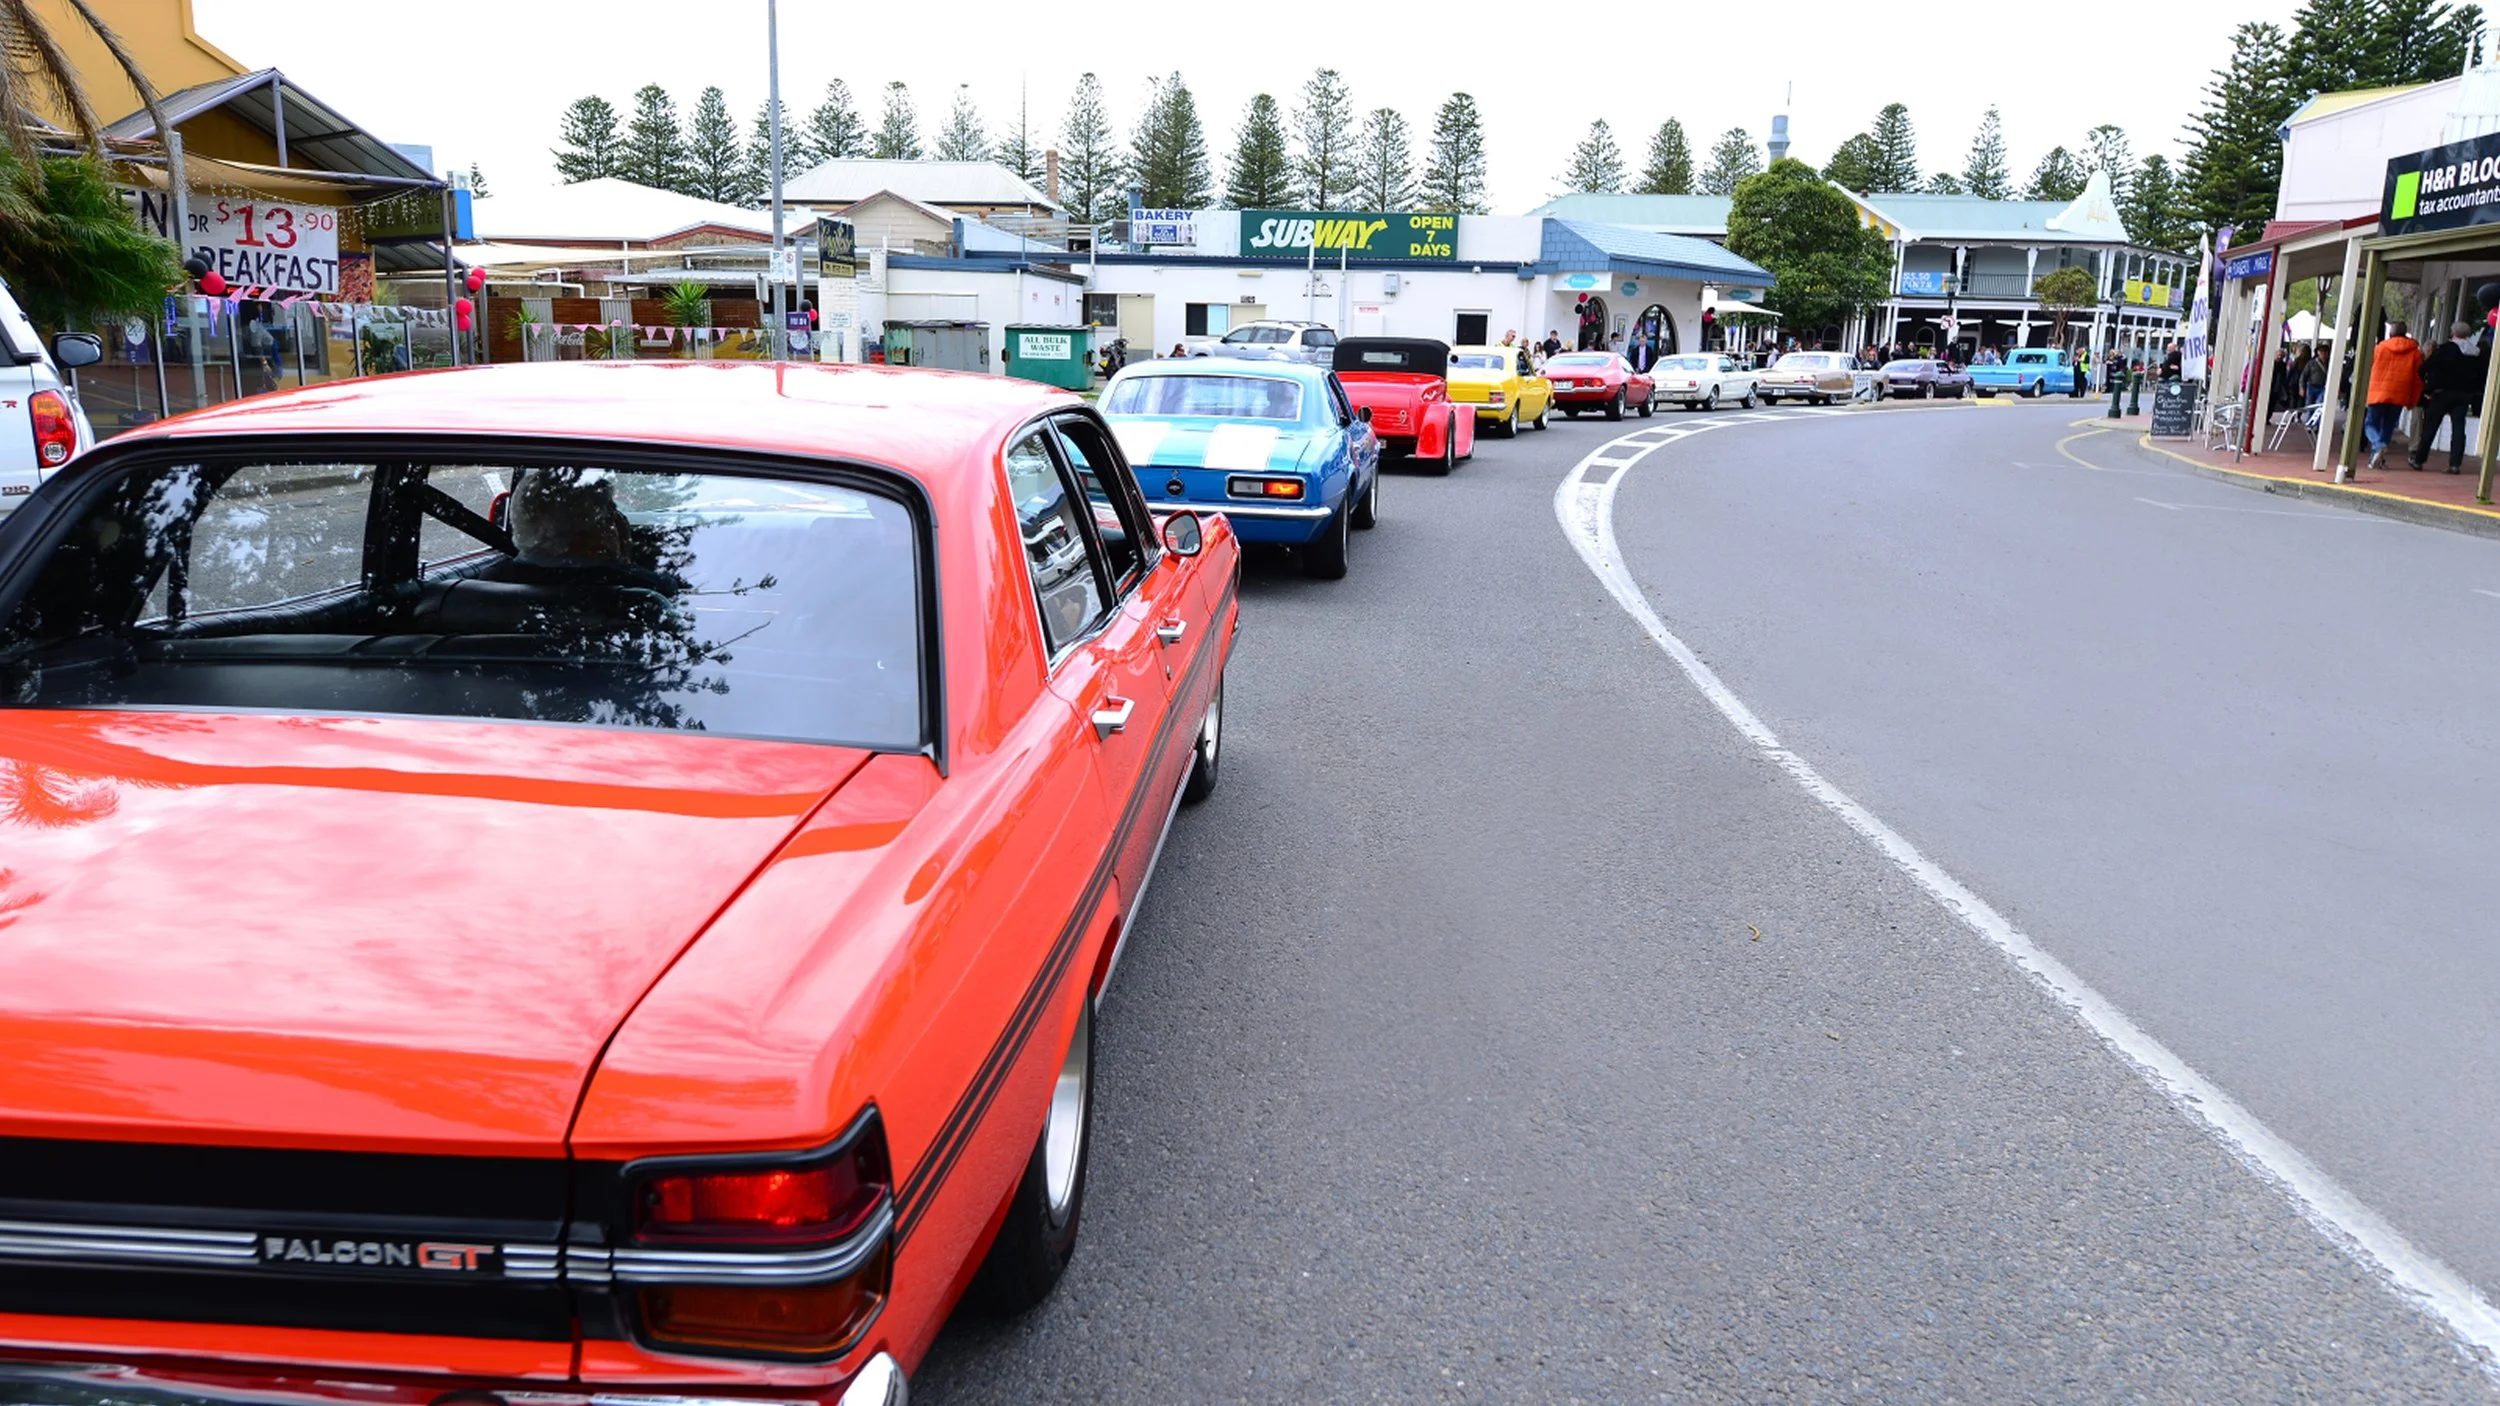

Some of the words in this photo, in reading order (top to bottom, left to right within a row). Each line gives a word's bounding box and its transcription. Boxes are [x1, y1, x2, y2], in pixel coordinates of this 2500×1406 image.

[2421, 165, 2456, 194] H&R
[2419, 200, 2436, 216] tax
[1135, 210, 1193, 220] BAKERY
[188, 213, 209, 233] OR
[1410, 216, 1453, 229] OPEN
[1250, 218, 1388, 249] SUBWAY
[1426, 231, 1436, 242] 7
[1410, 244, 1451, 256] DAYS
[1024, 336, 1041, 344] ALL
[1030, 344, 1061, 352] WASTE
[265, 1237, 411, 1266] FALCON
[418, 1242, 494, 1271] GT
